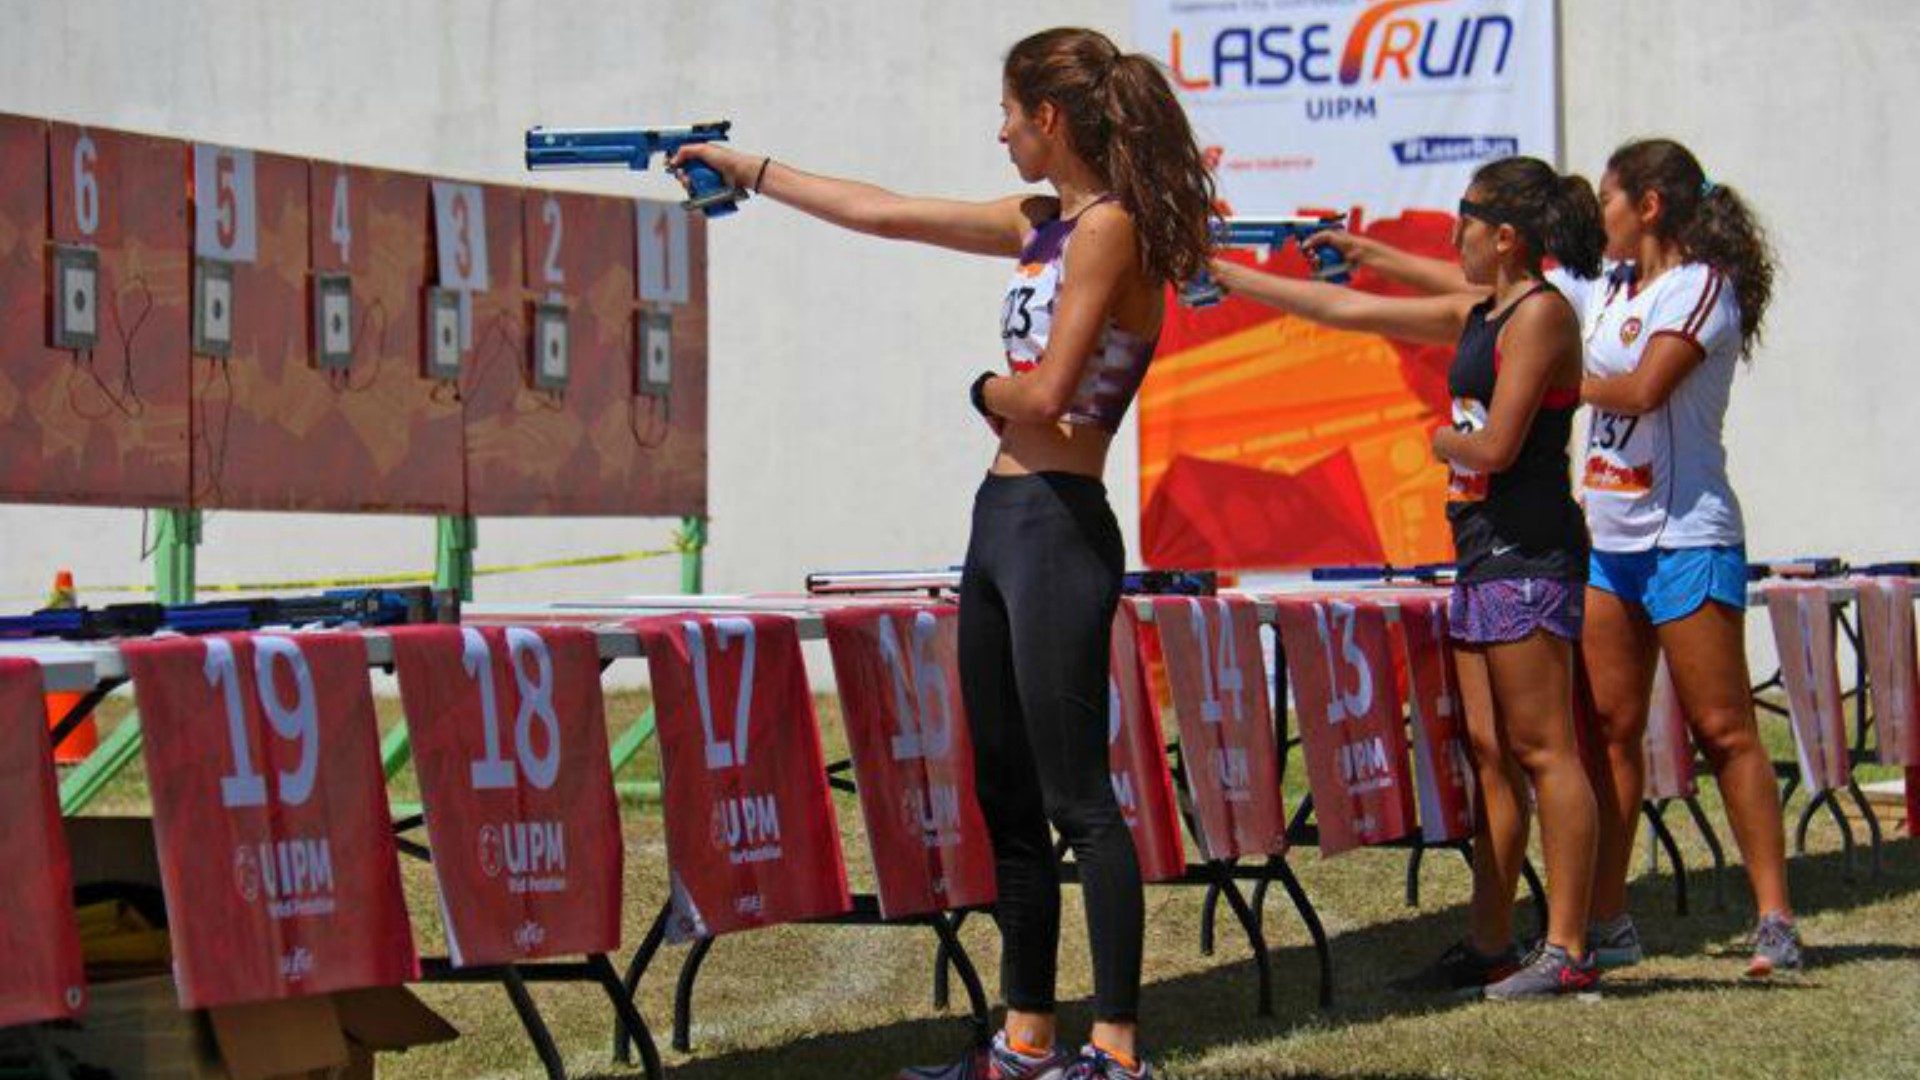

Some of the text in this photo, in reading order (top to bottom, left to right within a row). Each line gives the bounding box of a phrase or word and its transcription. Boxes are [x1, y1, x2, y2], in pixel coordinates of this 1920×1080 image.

[1306, 96, 1377, 122] UIPM
[73, 134, 99, 236] 6
[216, 156, 236, 249] 5
[331, 174, 352, 264] 4
[451, 195, 473, 279] 3
[543, 200, 564, 283] 2
[653, 211, 671, 292] 1
[685, 618, 755, 769] 17
[879, 611, 951, 760] 16
[1190, 597, 1243, 723] 14
[1313, 601, 1374, 725] 13
[204, 635, 320, 807] 19
[461, 627, 560, 790] 18
[259, 838, 335, 899] UIPM
[502, 821, 566, 874] UIPM
